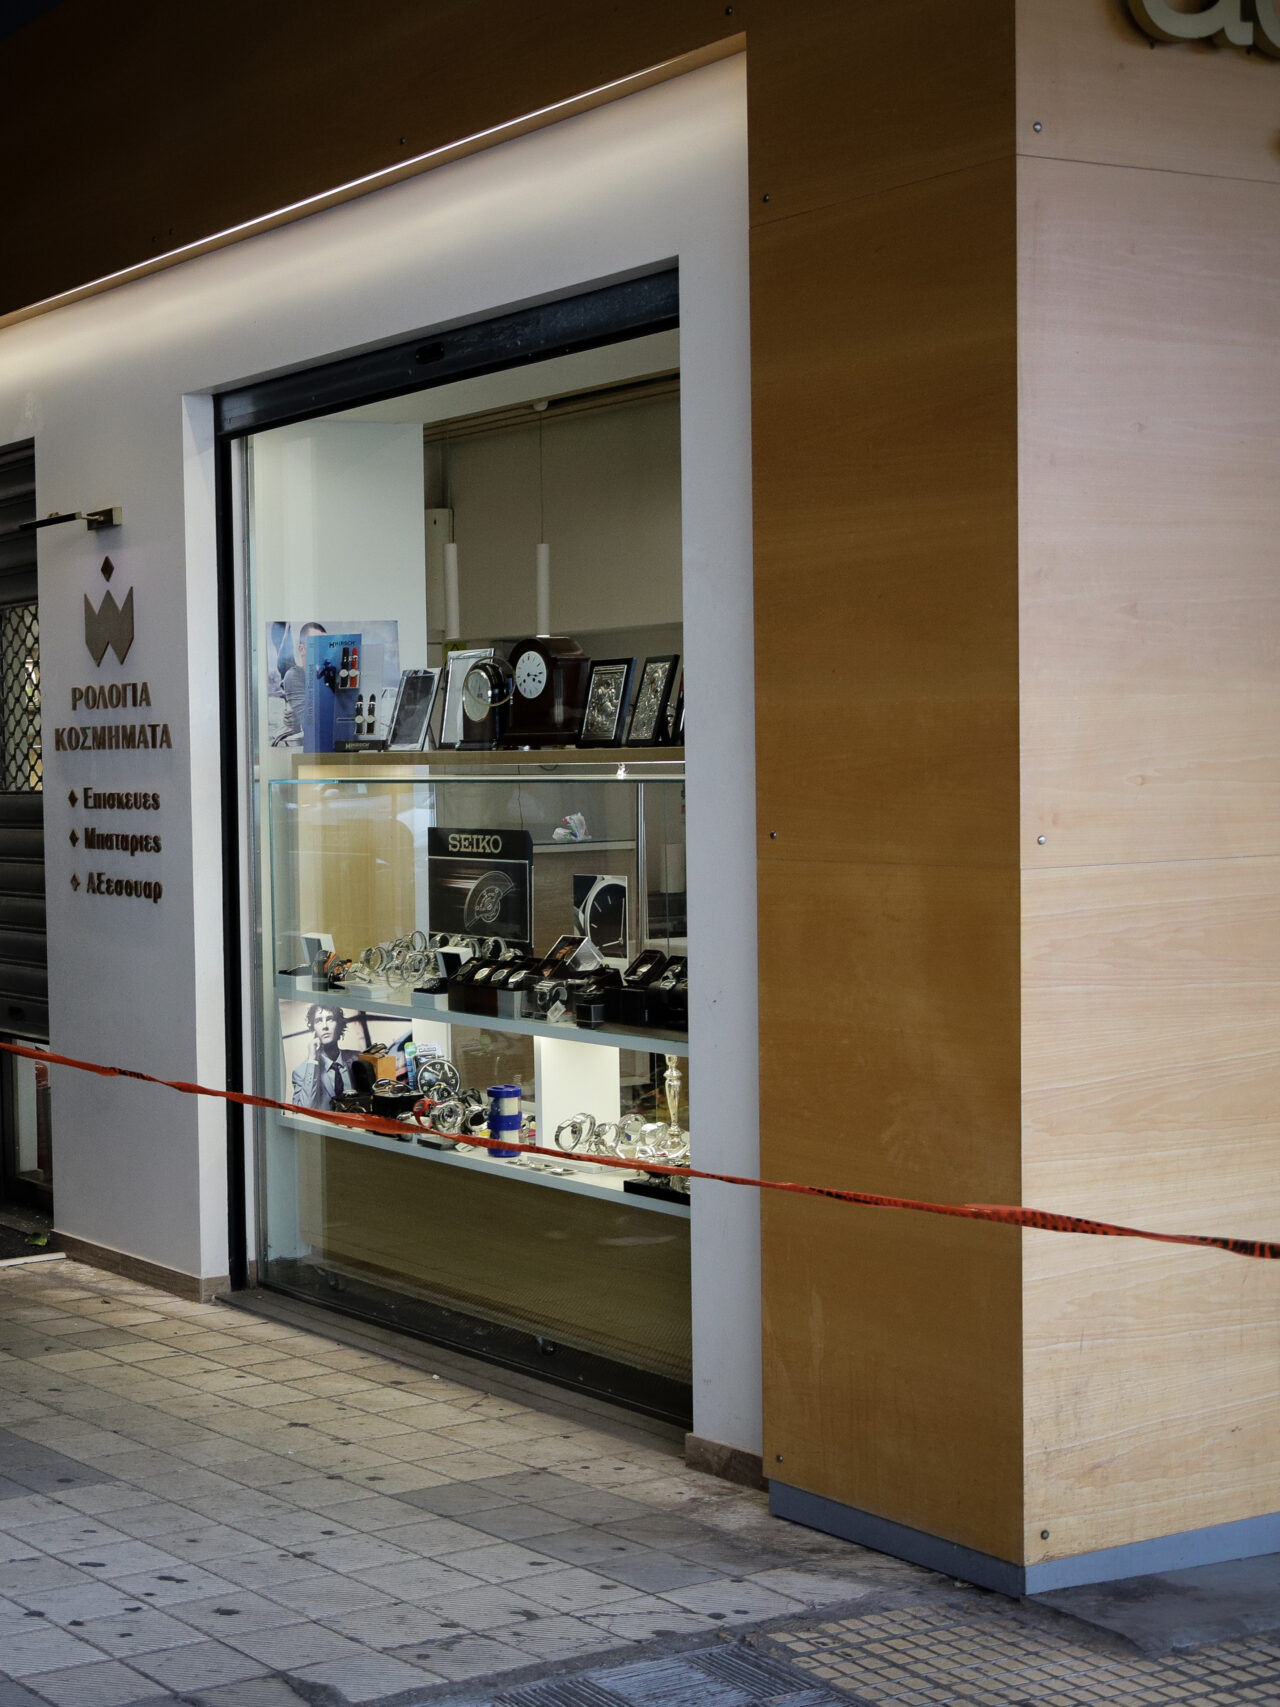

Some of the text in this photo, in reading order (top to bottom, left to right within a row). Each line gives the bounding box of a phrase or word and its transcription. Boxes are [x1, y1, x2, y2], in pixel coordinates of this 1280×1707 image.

[71, 682, 152, 711] ΡΟΛΟΓΙΑ
[54, 724, 173, 752] ΚΟΣΜΗΜΑΤΑ
[448, 833, 502, 853] SEIKO
